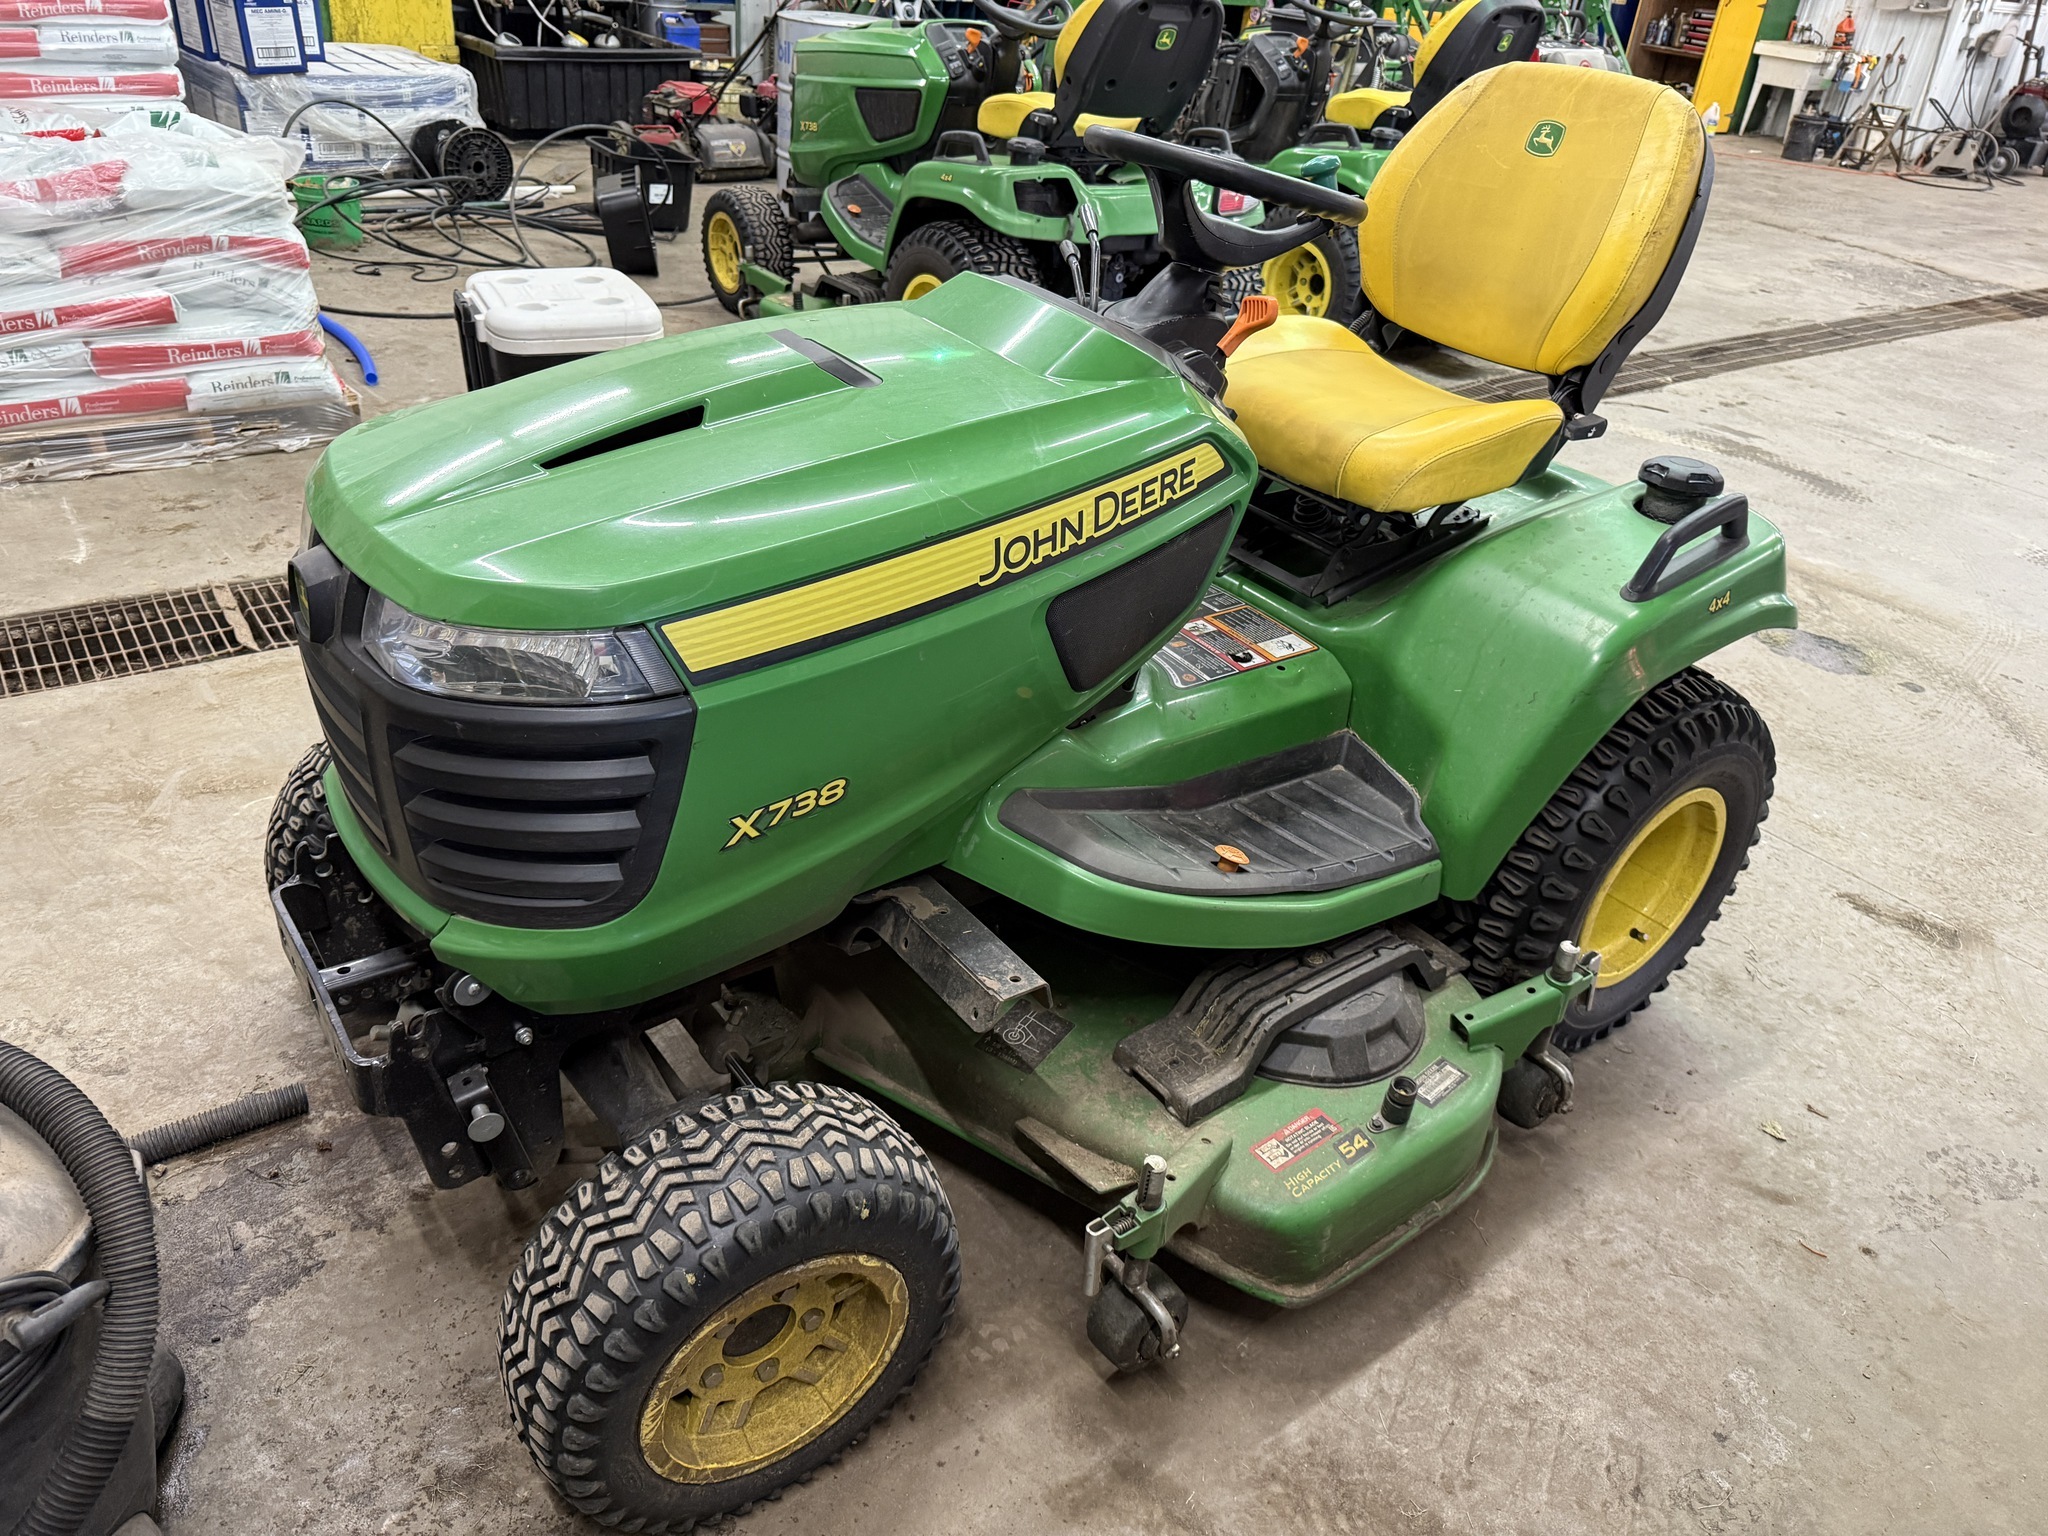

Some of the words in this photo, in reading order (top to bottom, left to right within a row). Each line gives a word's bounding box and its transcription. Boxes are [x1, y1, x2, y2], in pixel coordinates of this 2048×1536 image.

[17, 0, 85, 18] Reinders
[60, 29, 118, 44] Reinders
[29, 78, 97, 94] Reinders
[137, 238, 210, 261] Reinders
[168, 344, 242, 364] Reinders
[210, 376, 275, 394] Reinders
[979, 509, 1084, 584] JOHN
[1093, 456, 1197, 534] DEERE
[1708, 590, 1731, 613] 4x4
[719, 776, 849, 852] X738
[1288, 1115, 1311, 1132] DANGER
[1338, 1133, 1369, 1159] 54
[1283, 1167, 1313, 1190] HIGH
[1291, 1159, 1342, 1198] CAPACITY
